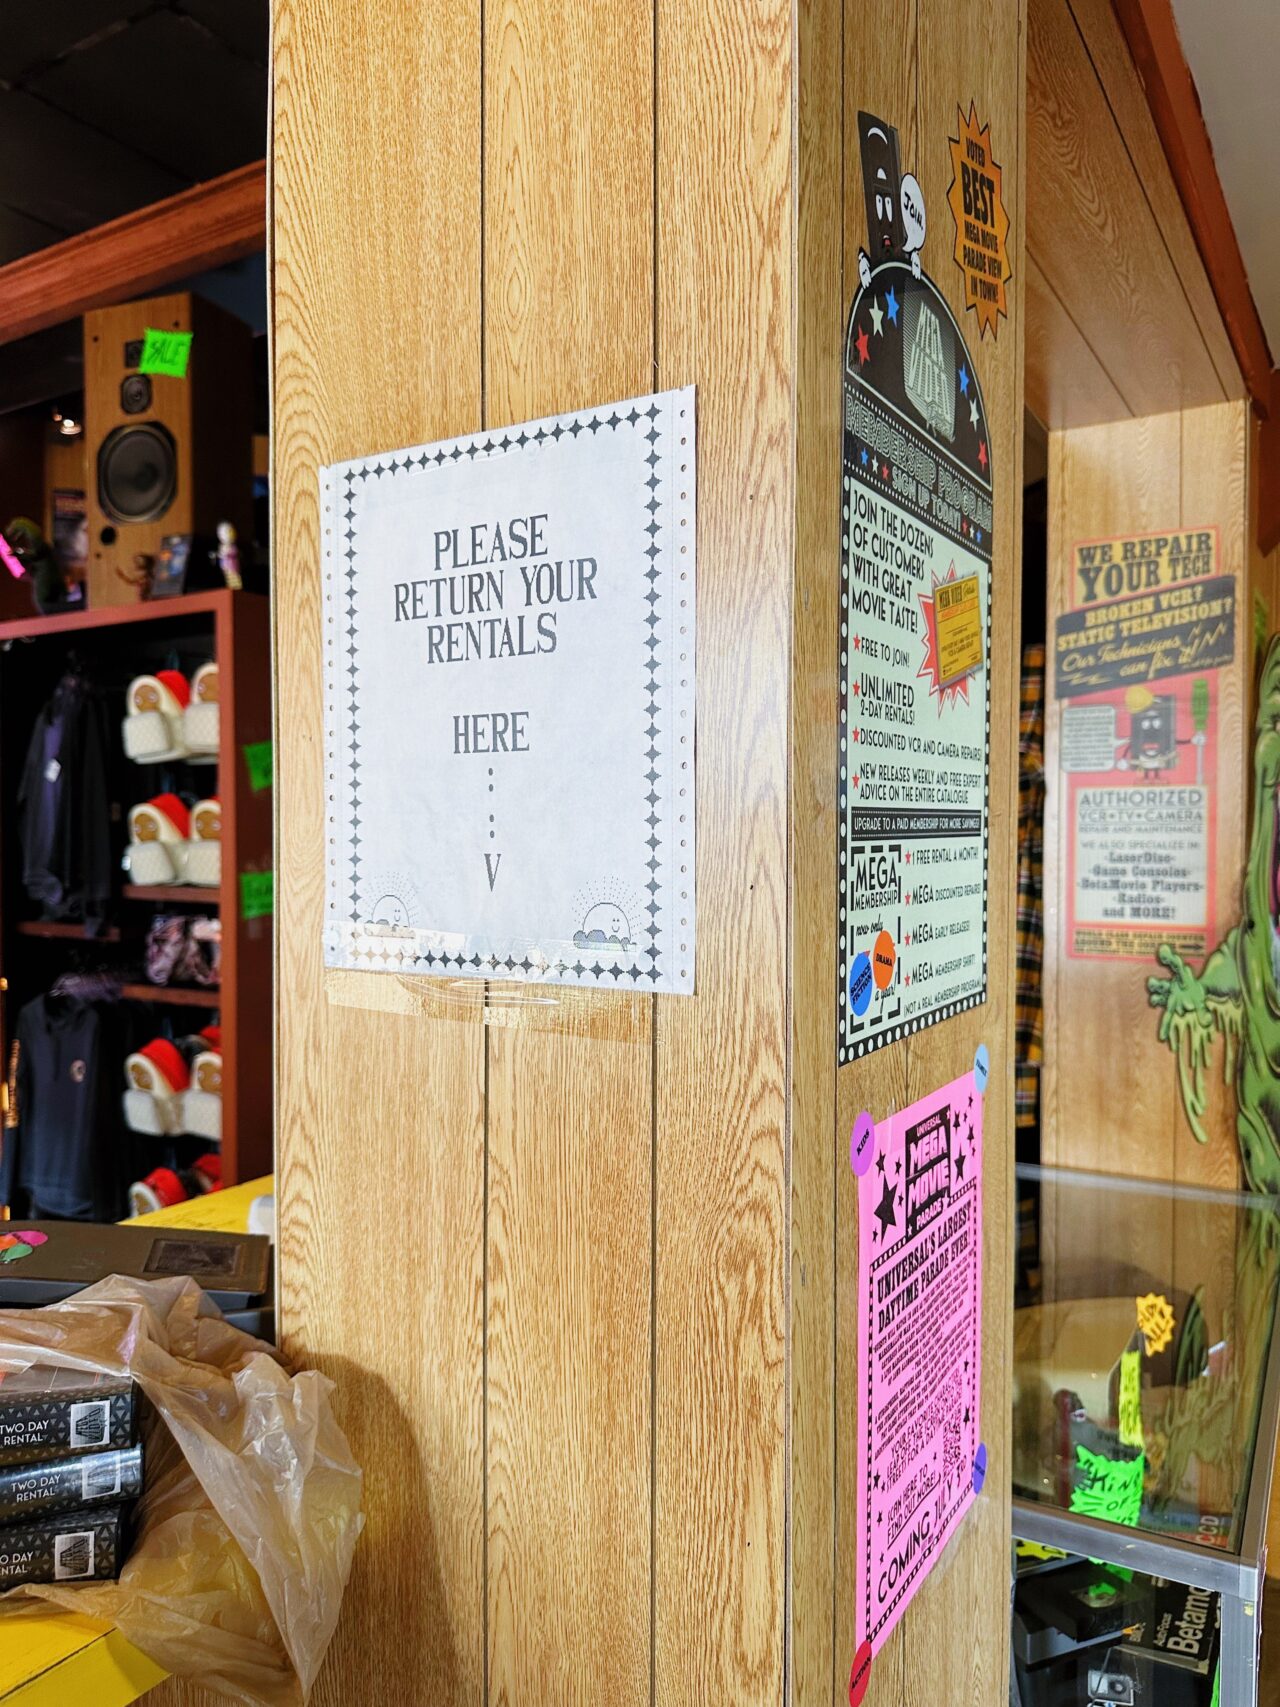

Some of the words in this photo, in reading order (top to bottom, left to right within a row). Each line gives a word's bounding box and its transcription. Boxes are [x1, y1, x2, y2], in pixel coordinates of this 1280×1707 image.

[966, 136, 985, 168] VOTED
[961, 160, 995, 228] BEST
[965, 219, 980, 245] MEGA
[981, 228, 998, 254] MOVIE
[963, 244, 987, 274] PARADE
[987, 256, 1002, 280] VIEW
[971, 274, 978, 297] IN
[907, 341, 952, 426] VIDEO
[846, 393, 937, 491] MEMBERSHIP
[938, 466, 992, 533] PROGRAM
[892, 465, 917, 502] SIGN
[918, 483, 931, 510] UP
[853, 489, 878, 527] JOIN
[880, 505, 898, 539] THE
[900, 518, 934, 560] DOZENS
[434, 513, 549, 571] PLEASE
[852, 523, 869, 552] OF
[871, 533, 926, 582] CUSTOMERS
[1077, 544, 1113, 568] WE
[1121, 532, 1212, 562] REPAIR
[394, 570, 506, 622] RETURN
[519, 557, 602, 607] YOUR
[852, 552, 879, 590] WITH
[881, 568, 913, 604] GREAT
[1077, 560, 1160, 604] YOUR
[1168, 554, 1212, 583] TECH
[852, 586, 886, 622] MOVIE
[888, 600, 918, 635] TASTE!
[1084, 595, 1156, 629] BROKEN
[427, 611, 559, 664] RENTALS
[861, 636, 878, 659] FREE
[880, 641, 890, 662] TO
[892, 648, 910, 668] JOIN!
[1056, 623, 1116, 652] STATIC
[1061, 652, 1096, 672] Our
[861, 672, 915, 708] UNLIMITED
[860, 698, 883, 720] 2-DAY
[884, 705, 915, 726] RENTALS!
[452, 711, 530, 754] HERE
[860, 728, 906, 752] DISCOUNTED
[908, 736, 921, 754] VCR
[922, 740, 936, 756] AND
[937, 742, 960, 760] CAMERA
[860, 761, 877, 781] NEW
[878, 764, 911, 784] RELEASES
[911, 768, 935, 786] WEEKLY
[936, 771, 949, 786] AND
[950, 772, 962, 787] FREE
[860, 783, 887, 801] ADVICE
[889, 785, 899, 802] ON
[902, 786, 913, 802] THE
[914, 787, 935, 803] ENTIRE
[1079, 789, 1203, 808] AUTHORIZED
[853, 816, 882, 831] UPGRADE
[882, 817, 890, 831] TO
[896, 817, 909, 831] PAID
[909, 817, 939, 831] MEMBERSHIP
[1143, 809, 1203, 823] CAMERA
[916, 849, 931, 865] FREE
[932, 847, 952, 864] RENTAL
[855, 855, 898, 893] MEGA
[854, 889, 898, 911] MEMBERSHIP
[912, 884, 934, 906] MEGA
[1102, 906, 1125, 918] and
[912, 922, 934, 945] MEGA
[875, 952, 893, 968] DRAMA
[912, 962, 934, 985] MEGA
[856, 1127, 870, 1156] KIDS
[916, 1114, 941, 1137] UNIVERSAL
[909, 1124, 948, 1176] MEGA
[907, 1157, 950, 1219] MOVIE
[916, 1198, 943, 1231] PARADE
[877, 1230, 936, 1304] UNIVERSAL'S
[938, 1199, 971, 1250] LARGEST
[878, 1278, 919, 1334] DAYTIME
[920, 1247, 949, 1294] PARADE
[0, 1424, 25, 1437] TWO
[28, 1419, 50, 1431] DAY
[4, 1434, 44, 1446] RENTAL
[891, 1431, 906, 1461] YOUR
[906, 1399, 933, 1442] FAVORITE
[887, 1451, 900, 1480] LEAP
[907, 1440, 919, 1467] FOR
[11, 1479, 40, 1493] TWO
[41, 1474, 61, 1487] DAY
[17, 1486, 56, 1503] RENTAL
[887, 1493, 902, 1526] SCAN
[903, 1475, 918, 1509] HERE
[919, 1463, 928, 1486] TO
[887, 1512, 903, 1545] FIND
[904, 1493, 916, 1525] OUT
[877, 1509, 930, 1604] COMING
[934, 1473, 953, 1528] JULY
[0, 1564, 28, 1576] NTAL
[12, 1551, 34, 1563] DAY
